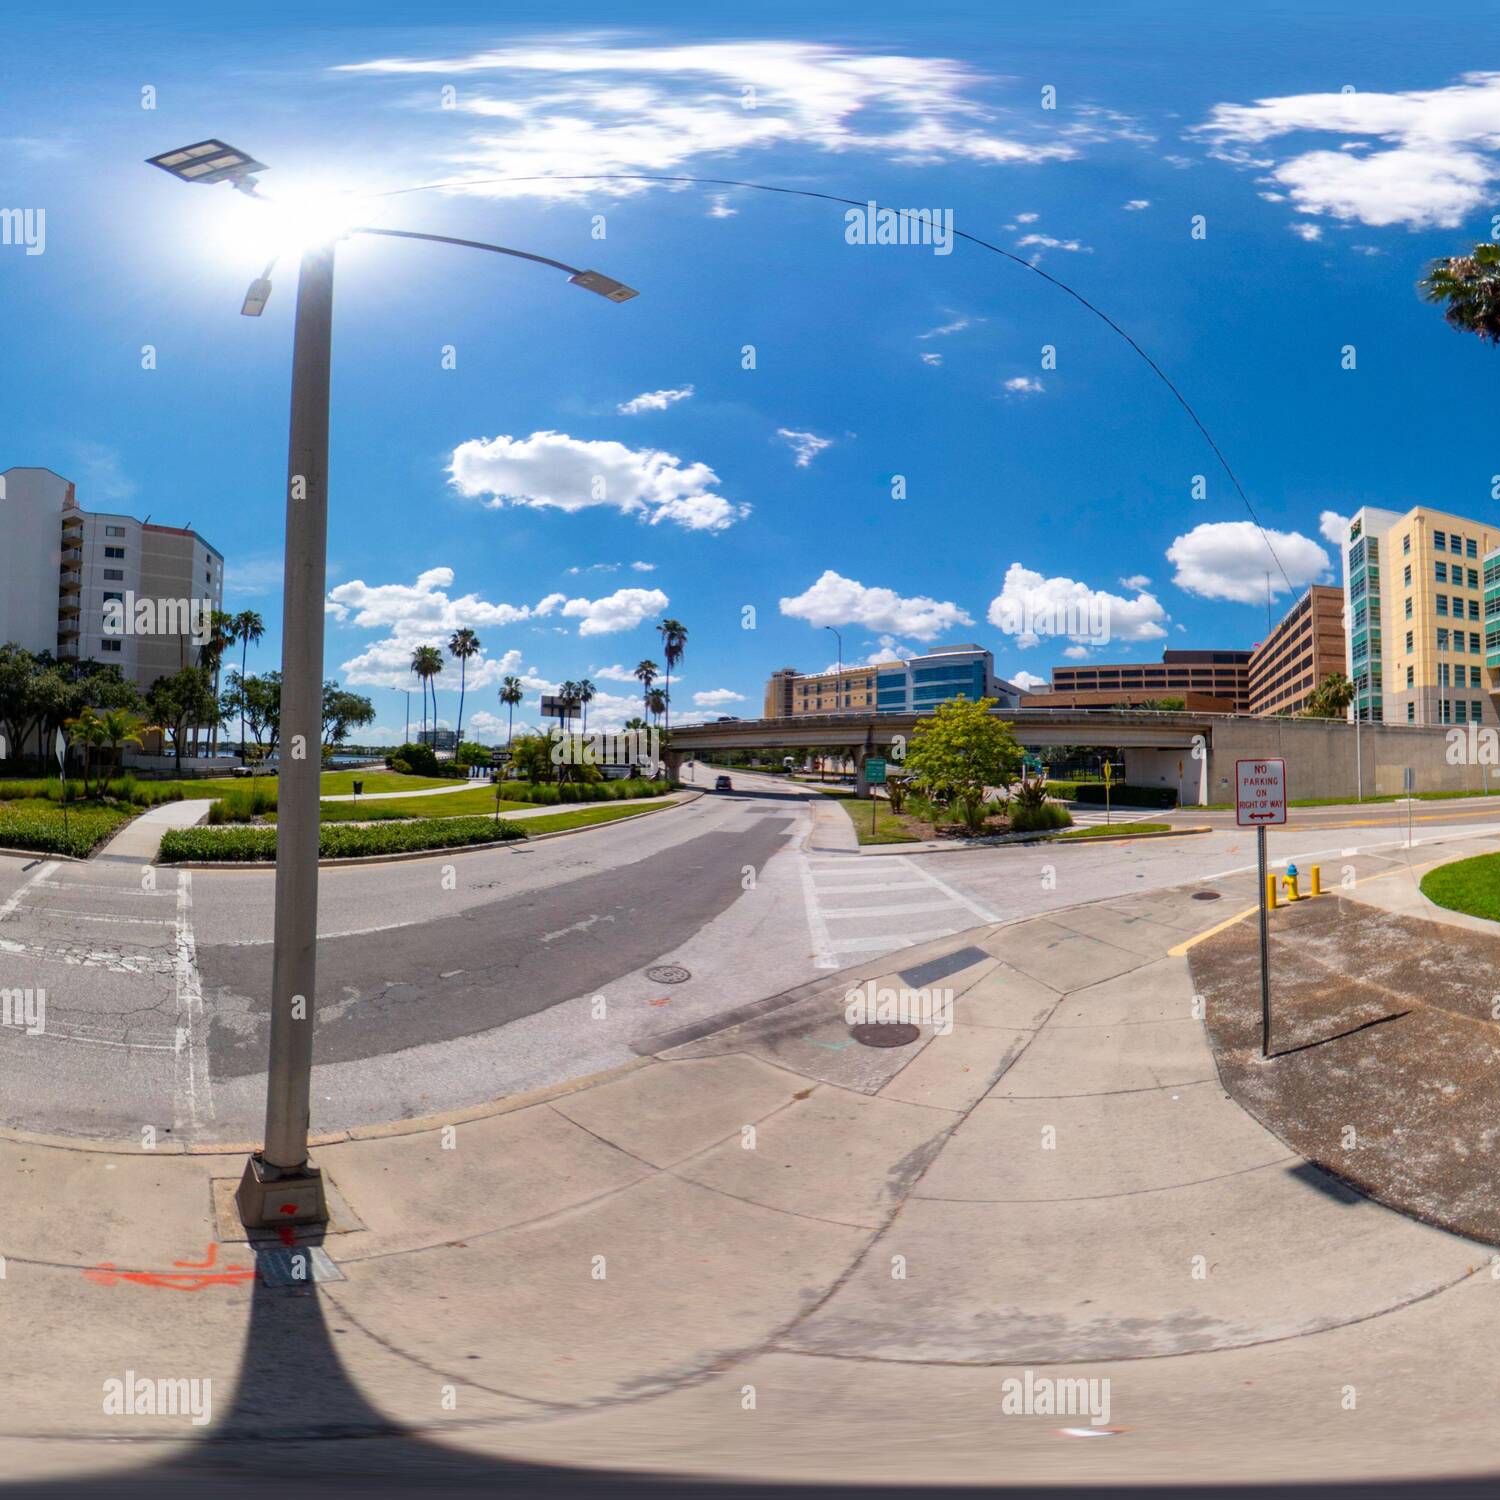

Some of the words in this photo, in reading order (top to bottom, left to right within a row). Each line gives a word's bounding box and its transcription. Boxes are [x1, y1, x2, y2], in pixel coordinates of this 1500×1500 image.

[1254, 764, 1267, 774] NO
[1243, 777, 1279, 786] PARKING
[1256, 789, 1267, 797] ON
[1239, 801, 1257, 809] RIGHT
[1260, 800, 1267, 808] OF
[1270, 800, 1283, 808] WAY
